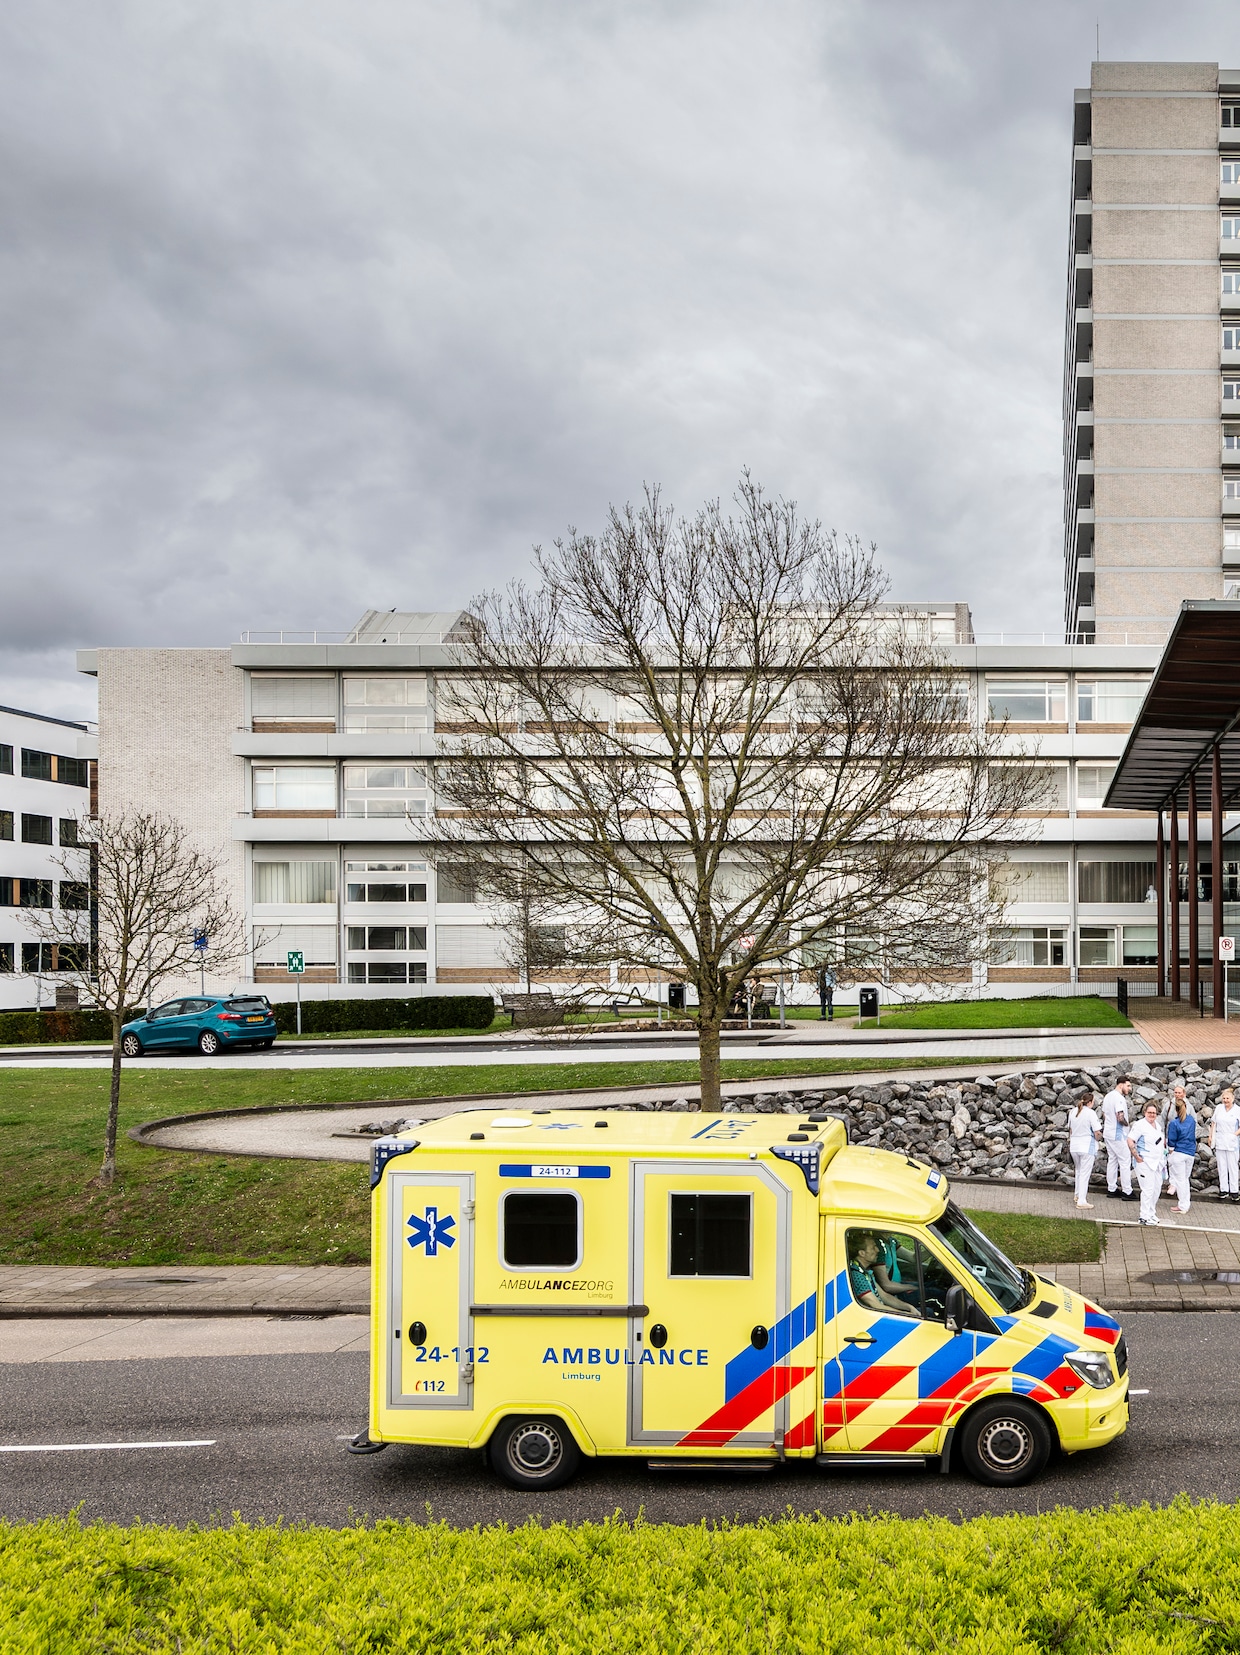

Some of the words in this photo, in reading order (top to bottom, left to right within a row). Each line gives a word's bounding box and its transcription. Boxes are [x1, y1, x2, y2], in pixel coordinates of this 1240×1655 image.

[539, 1167, 571, 1176] 24-112
[499, 1279, 614, 1291] AMBULANCEZORG
[415, 1346, 490, 1363] 24-112
[542, 1347, 709, 1366] AMBULANCE
[562, 1372, 601, 1382] Limburg
